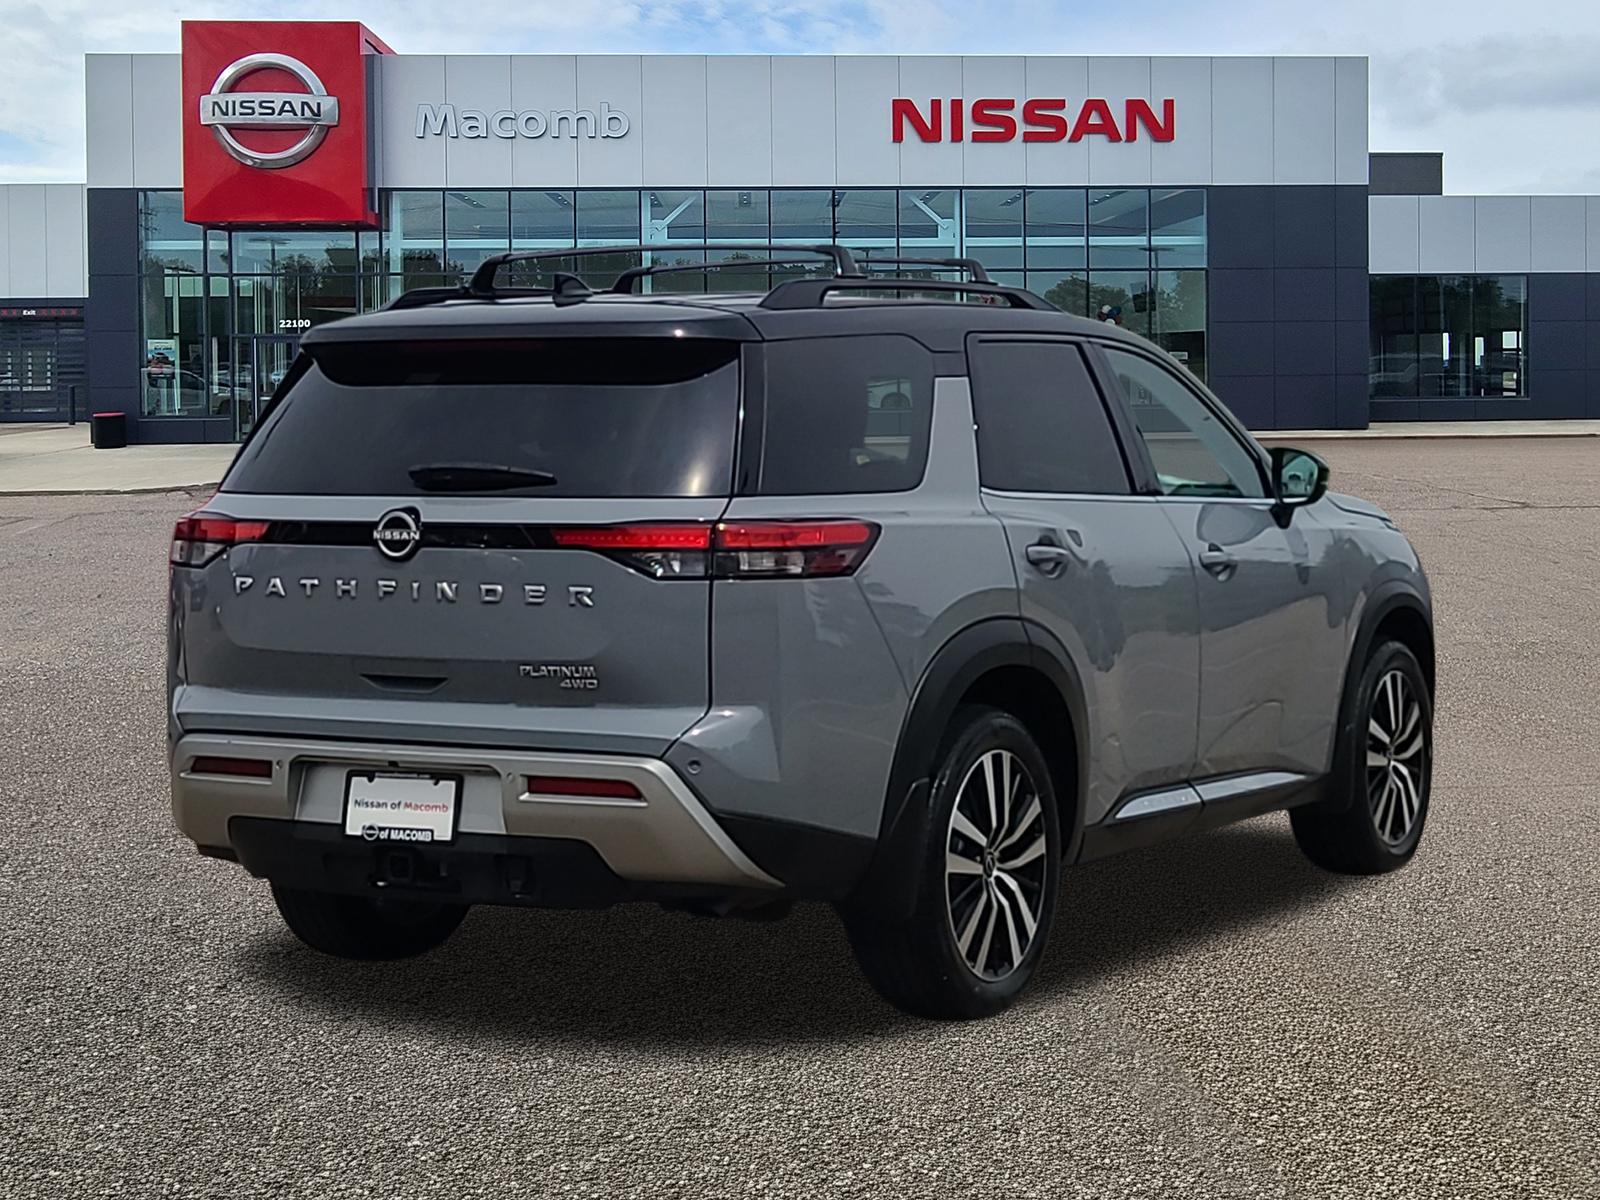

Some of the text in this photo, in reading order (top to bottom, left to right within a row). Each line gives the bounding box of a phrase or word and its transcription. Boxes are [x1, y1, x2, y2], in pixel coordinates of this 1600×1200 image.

[211, 100, 322, 117] NISSAN
[415, 101, 630, 139] Macomb
[891, 98, 1175, 143] NISSAN
[279, 319, 311, 328] 22100
[373, 530, 420, 540] NISSAN
[234, 576, 595, 606] PATHFINDER
[519, 665, 597, 677] PLATINUM
[559, 679, 598, 689] 4WD
[354, 798, 449, 813] Nissan of Macomb
[379, 829, 390, 840] of
[390, 829, 433, 842] MACOMB
